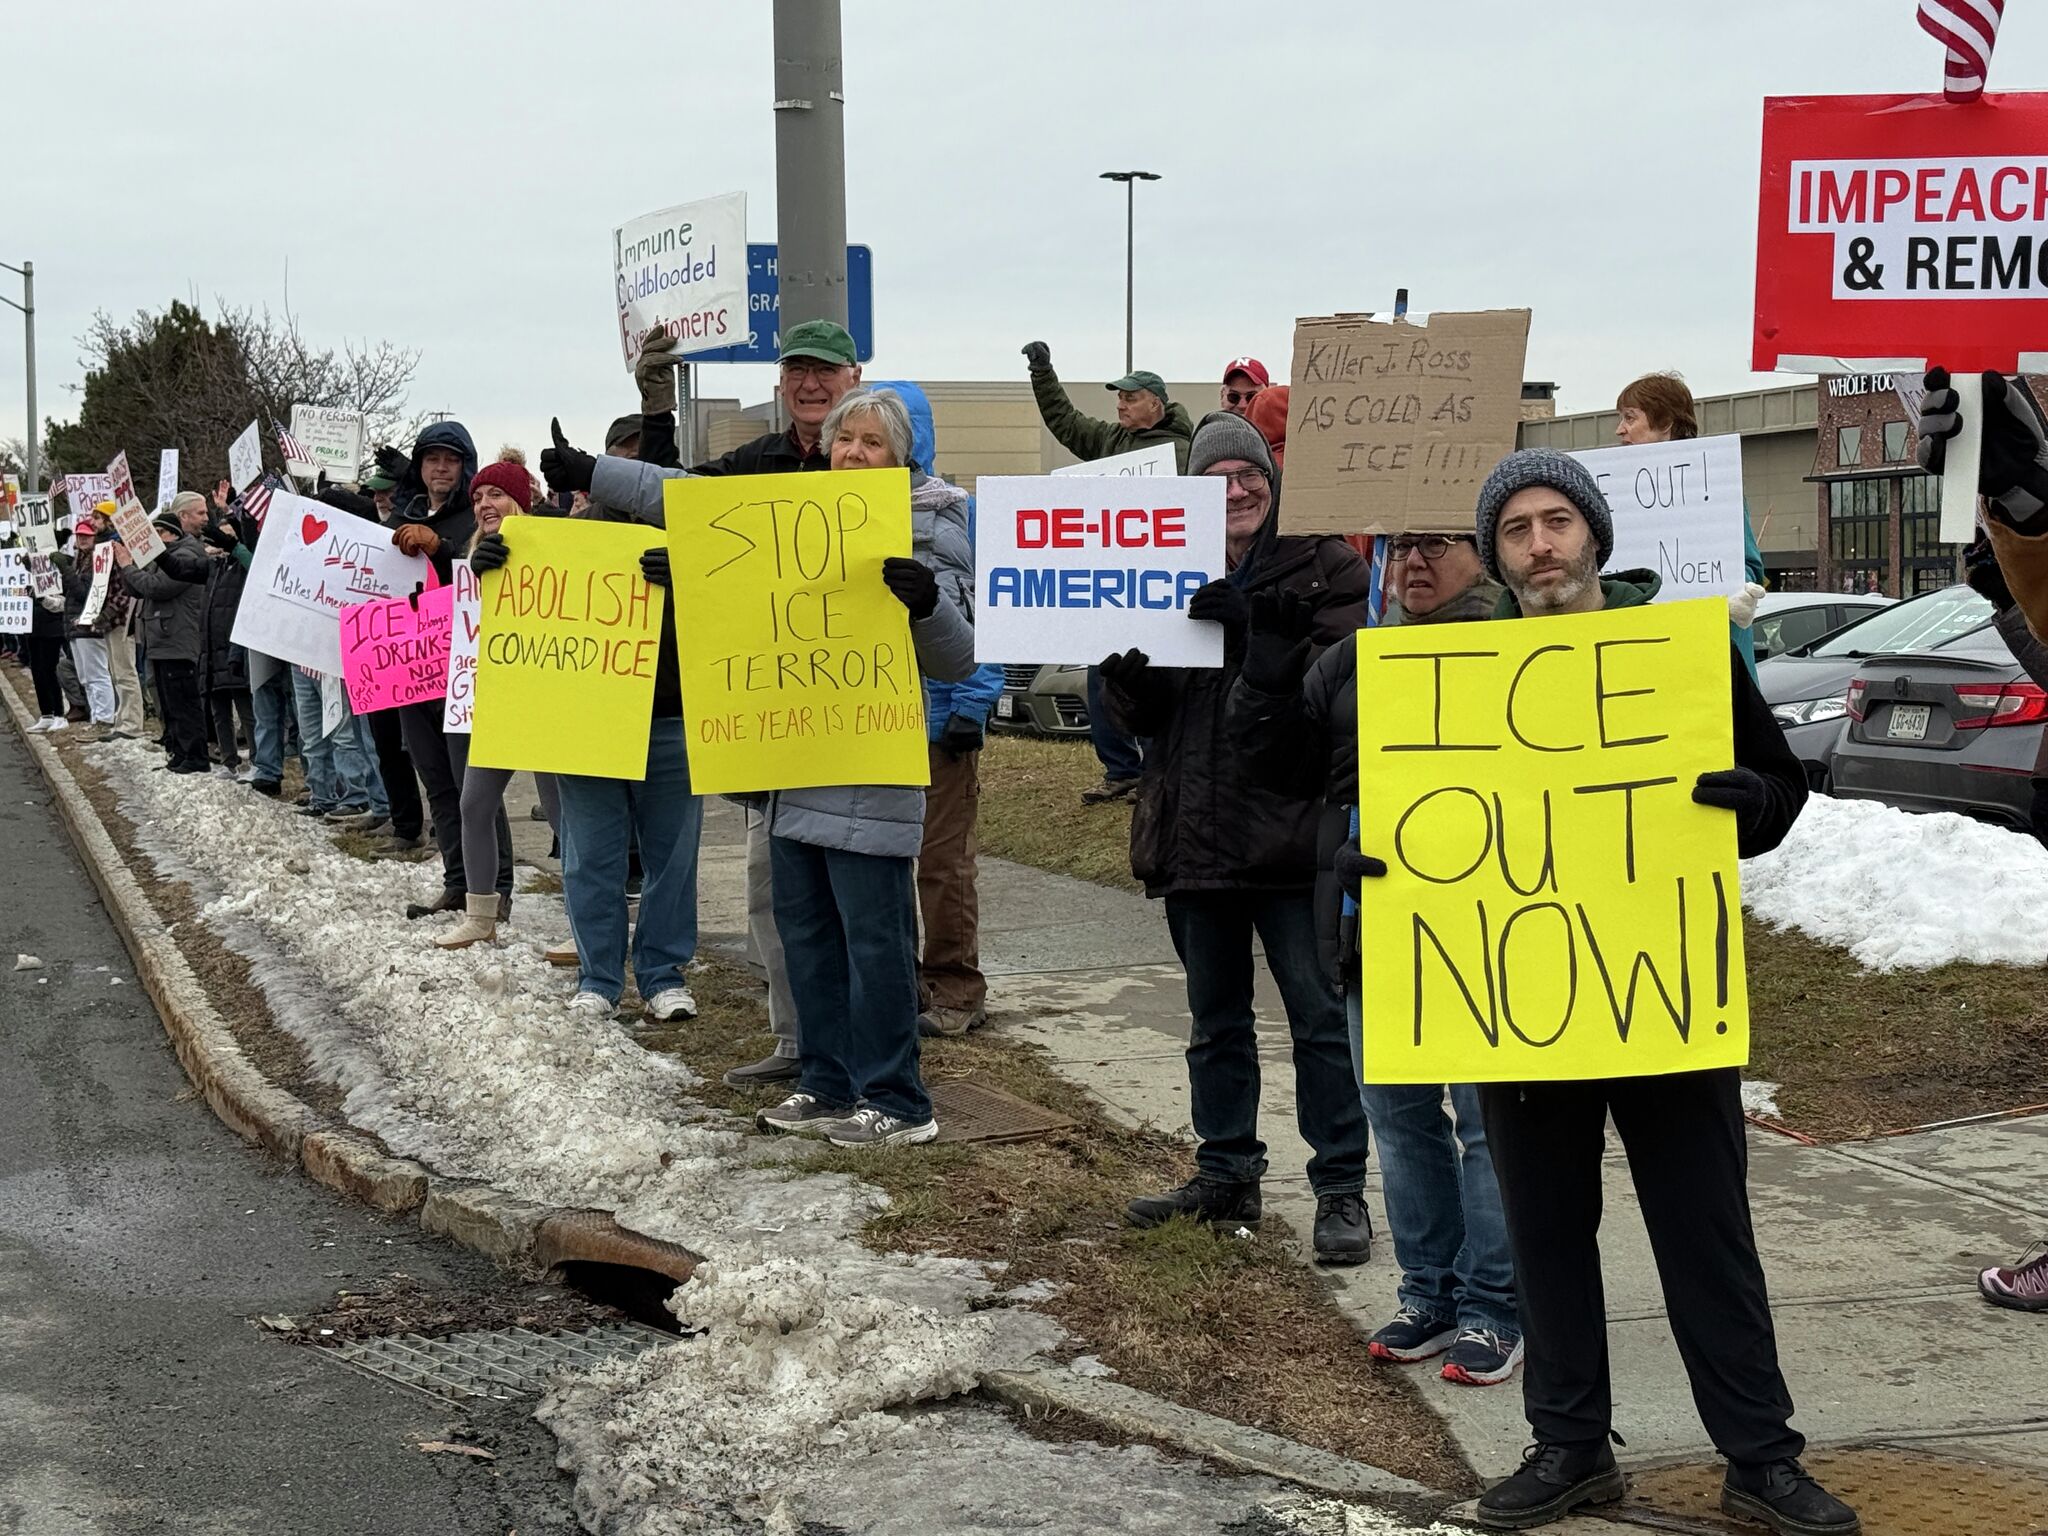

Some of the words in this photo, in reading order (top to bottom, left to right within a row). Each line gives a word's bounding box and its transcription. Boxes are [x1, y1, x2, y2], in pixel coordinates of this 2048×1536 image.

[615, 222, 693, 269] Immune
[1843, 236, 1884, 291] &
[617, 244, 716, 310] Coldblooded
[1303, 339, 1374, 383] Killer
[1827, 374, 1868, 397] WHOLE
[298, 408, 316, 420] NO
[319, 408, 360, 424] PERSON
[1298, 395, 1337, 433] AS
[1344, 393, 1421, 426] COLD
[1428, 392, 1476, 424] AS
[705, 491, 868, 582] STOP
[1016, 508, 1187, 549] DE-ICE
[328, 534, 385, 569] NOT
[273, 563, 311, 600] Makes
[350, 568, 390, 593] Hate
[494, 564, 651, 631] ABOLISH
[346, 601, 405, 654] ICE
[417, 608, 449, 635] belongs
[770, 588, 853, 643] ICE
[372, 630, 452, 671] DRINKS
[408, 657, 447, 681] NOT
[455, 654, 478, 671] are
[487, 631, 658, 679] COWARDICE
[710, 633, 913, 695] TERROR!
[1379, 636, 1671, 752] ICE
[701, 713, 747, 744] ONE
[756, 704, 816, 743] YEAR
[824, 703, 844, 735] IS
[856, 701, 924, 736] ENOUGH
[1395, 776, 1678, 896] OUT
[1412, 870, 1729, 1048] NOW!
